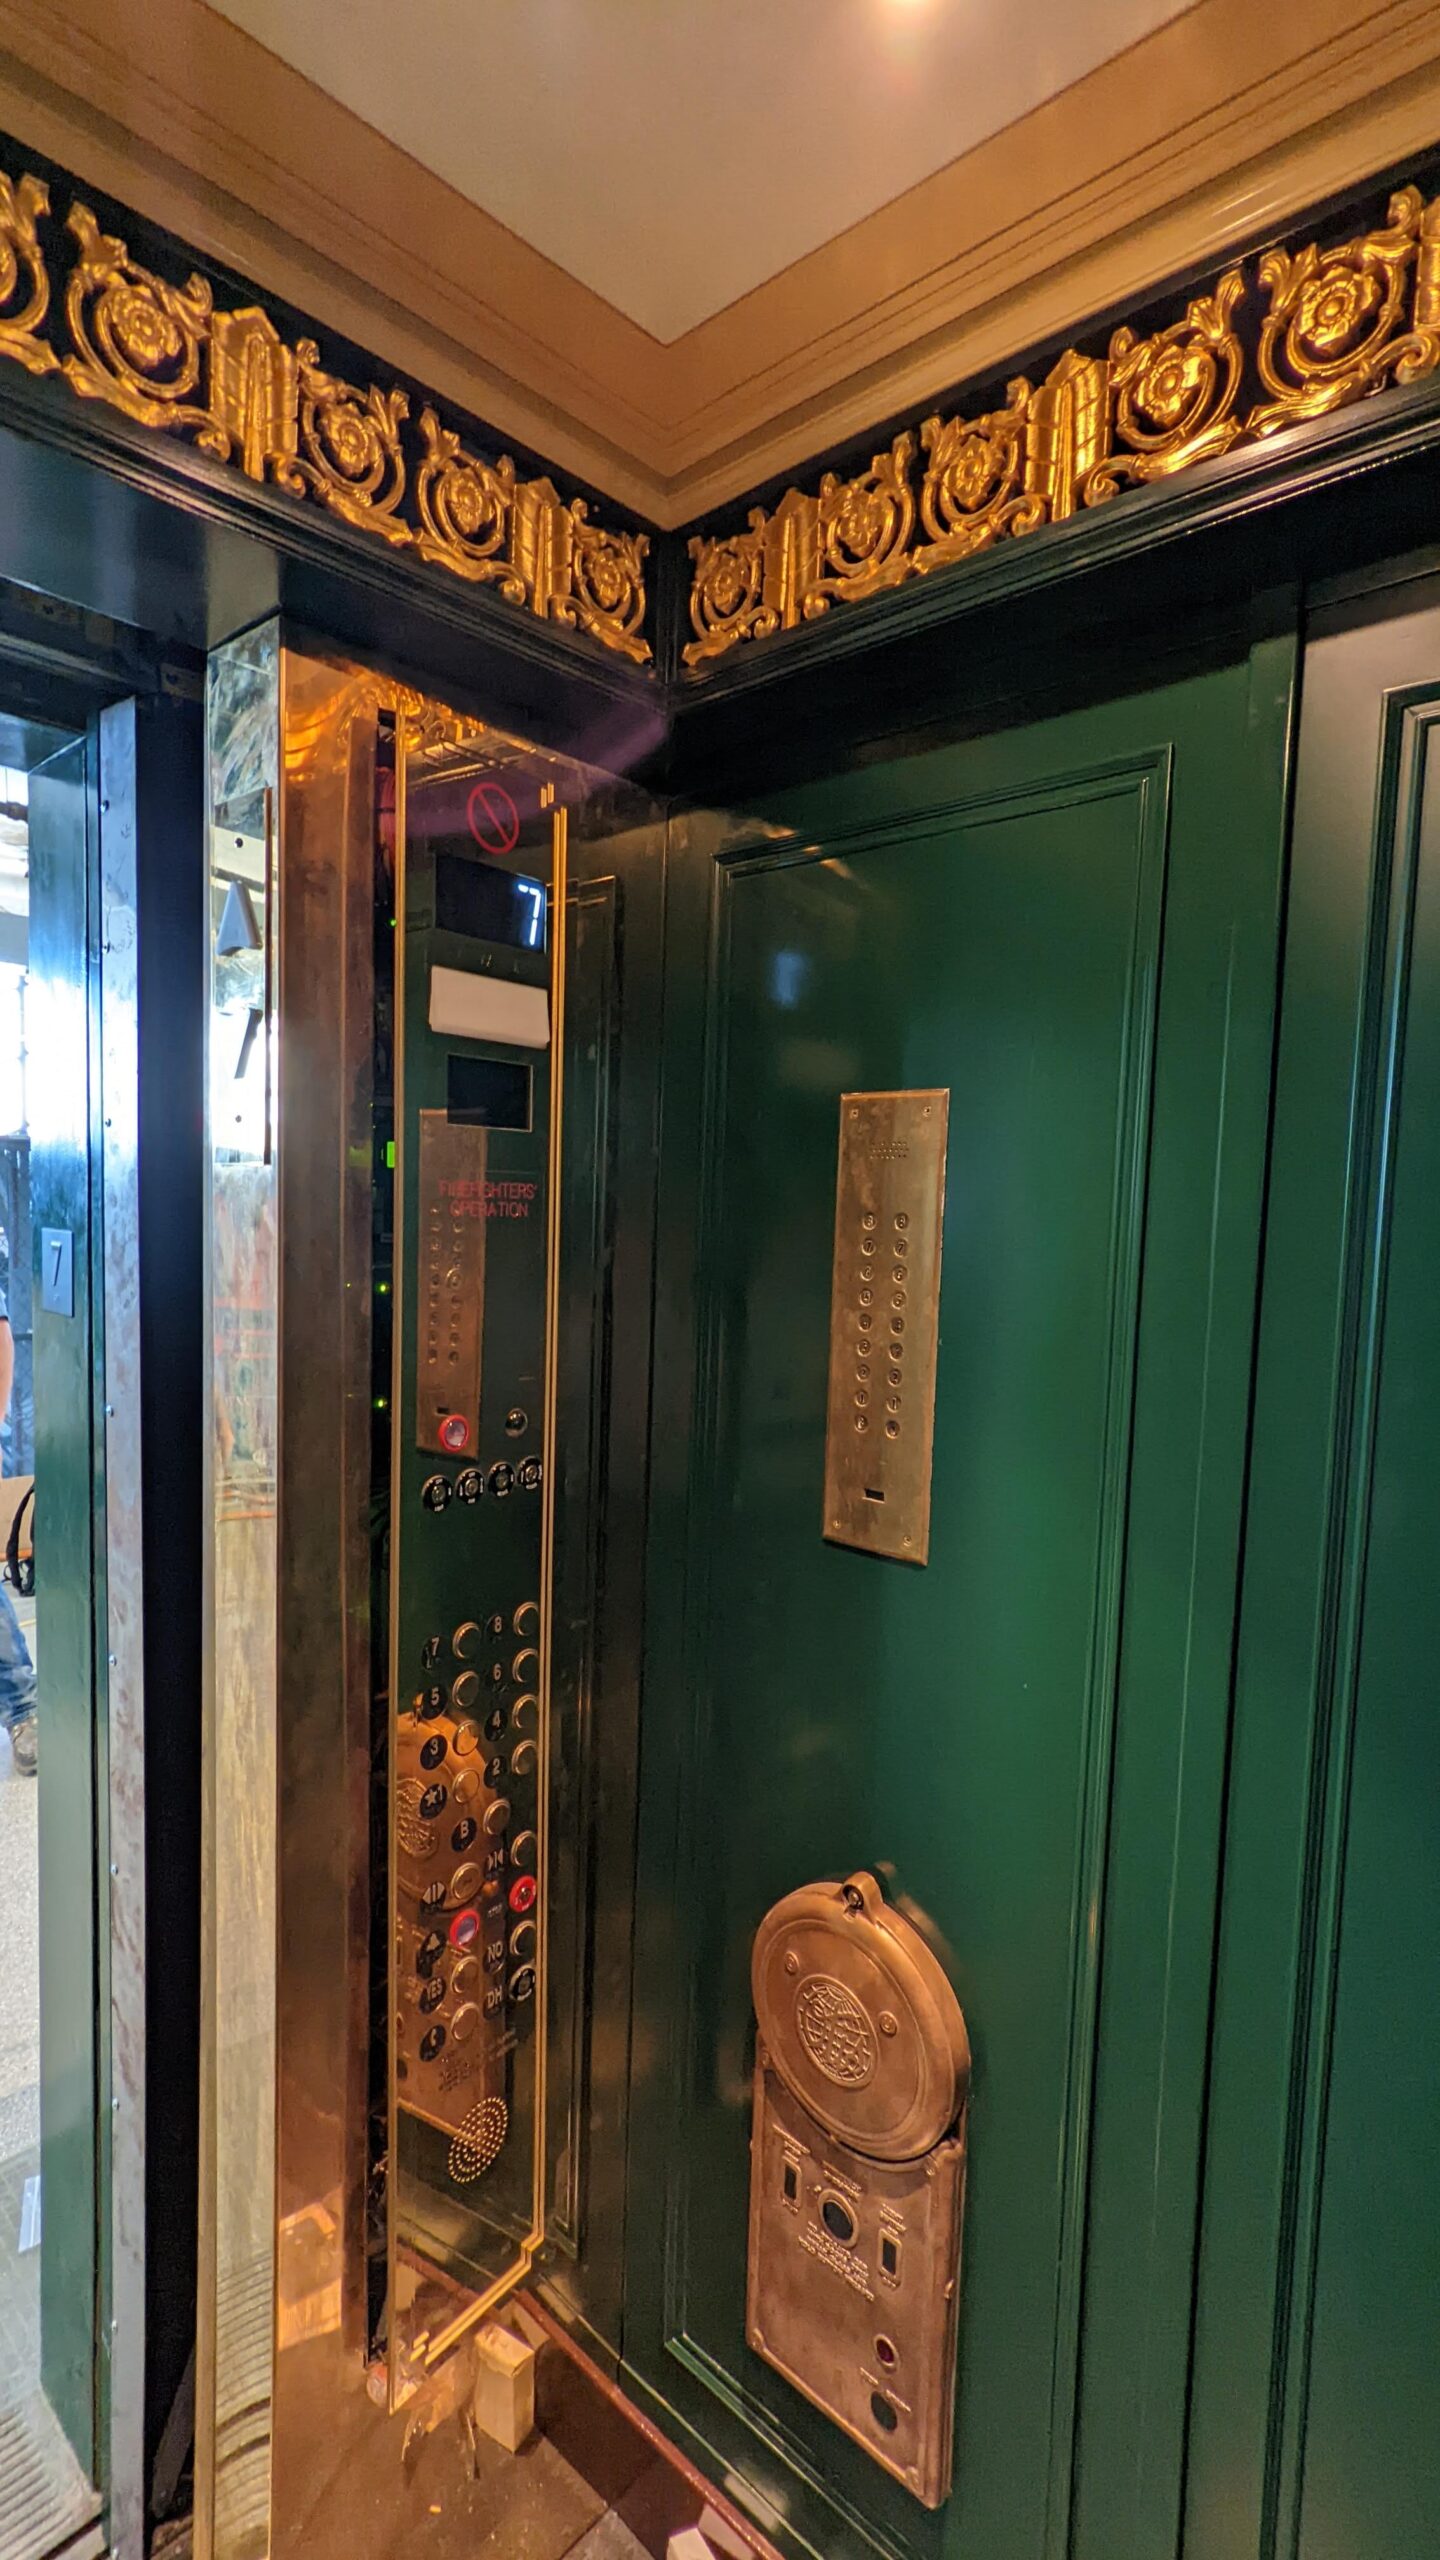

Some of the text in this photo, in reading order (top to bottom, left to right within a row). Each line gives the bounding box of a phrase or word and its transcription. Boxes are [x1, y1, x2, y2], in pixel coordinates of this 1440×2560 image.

[516, 883, 542, 946] 7
[447, 1200, 529, 1218] OPERATION
[49, 1240, 63, 1287] 7
[494, 1615, 503, 1633] 8
[431, 1637, 440, 1656] 7
[493, 1663, 502, 1680] 6
[430, 1688, 440, 1706] 5
[492, 1710, 501, 1728] 4
[430, 1739, 440, 1756] 3
[492, 1758, 501, 1776] 2
[460, 1819, 470, 1840] B
[487, 1940, 504, 1963] NO
[426, 1977, 443, 2001] YES
[487, 1984, 504, 2007] DH
